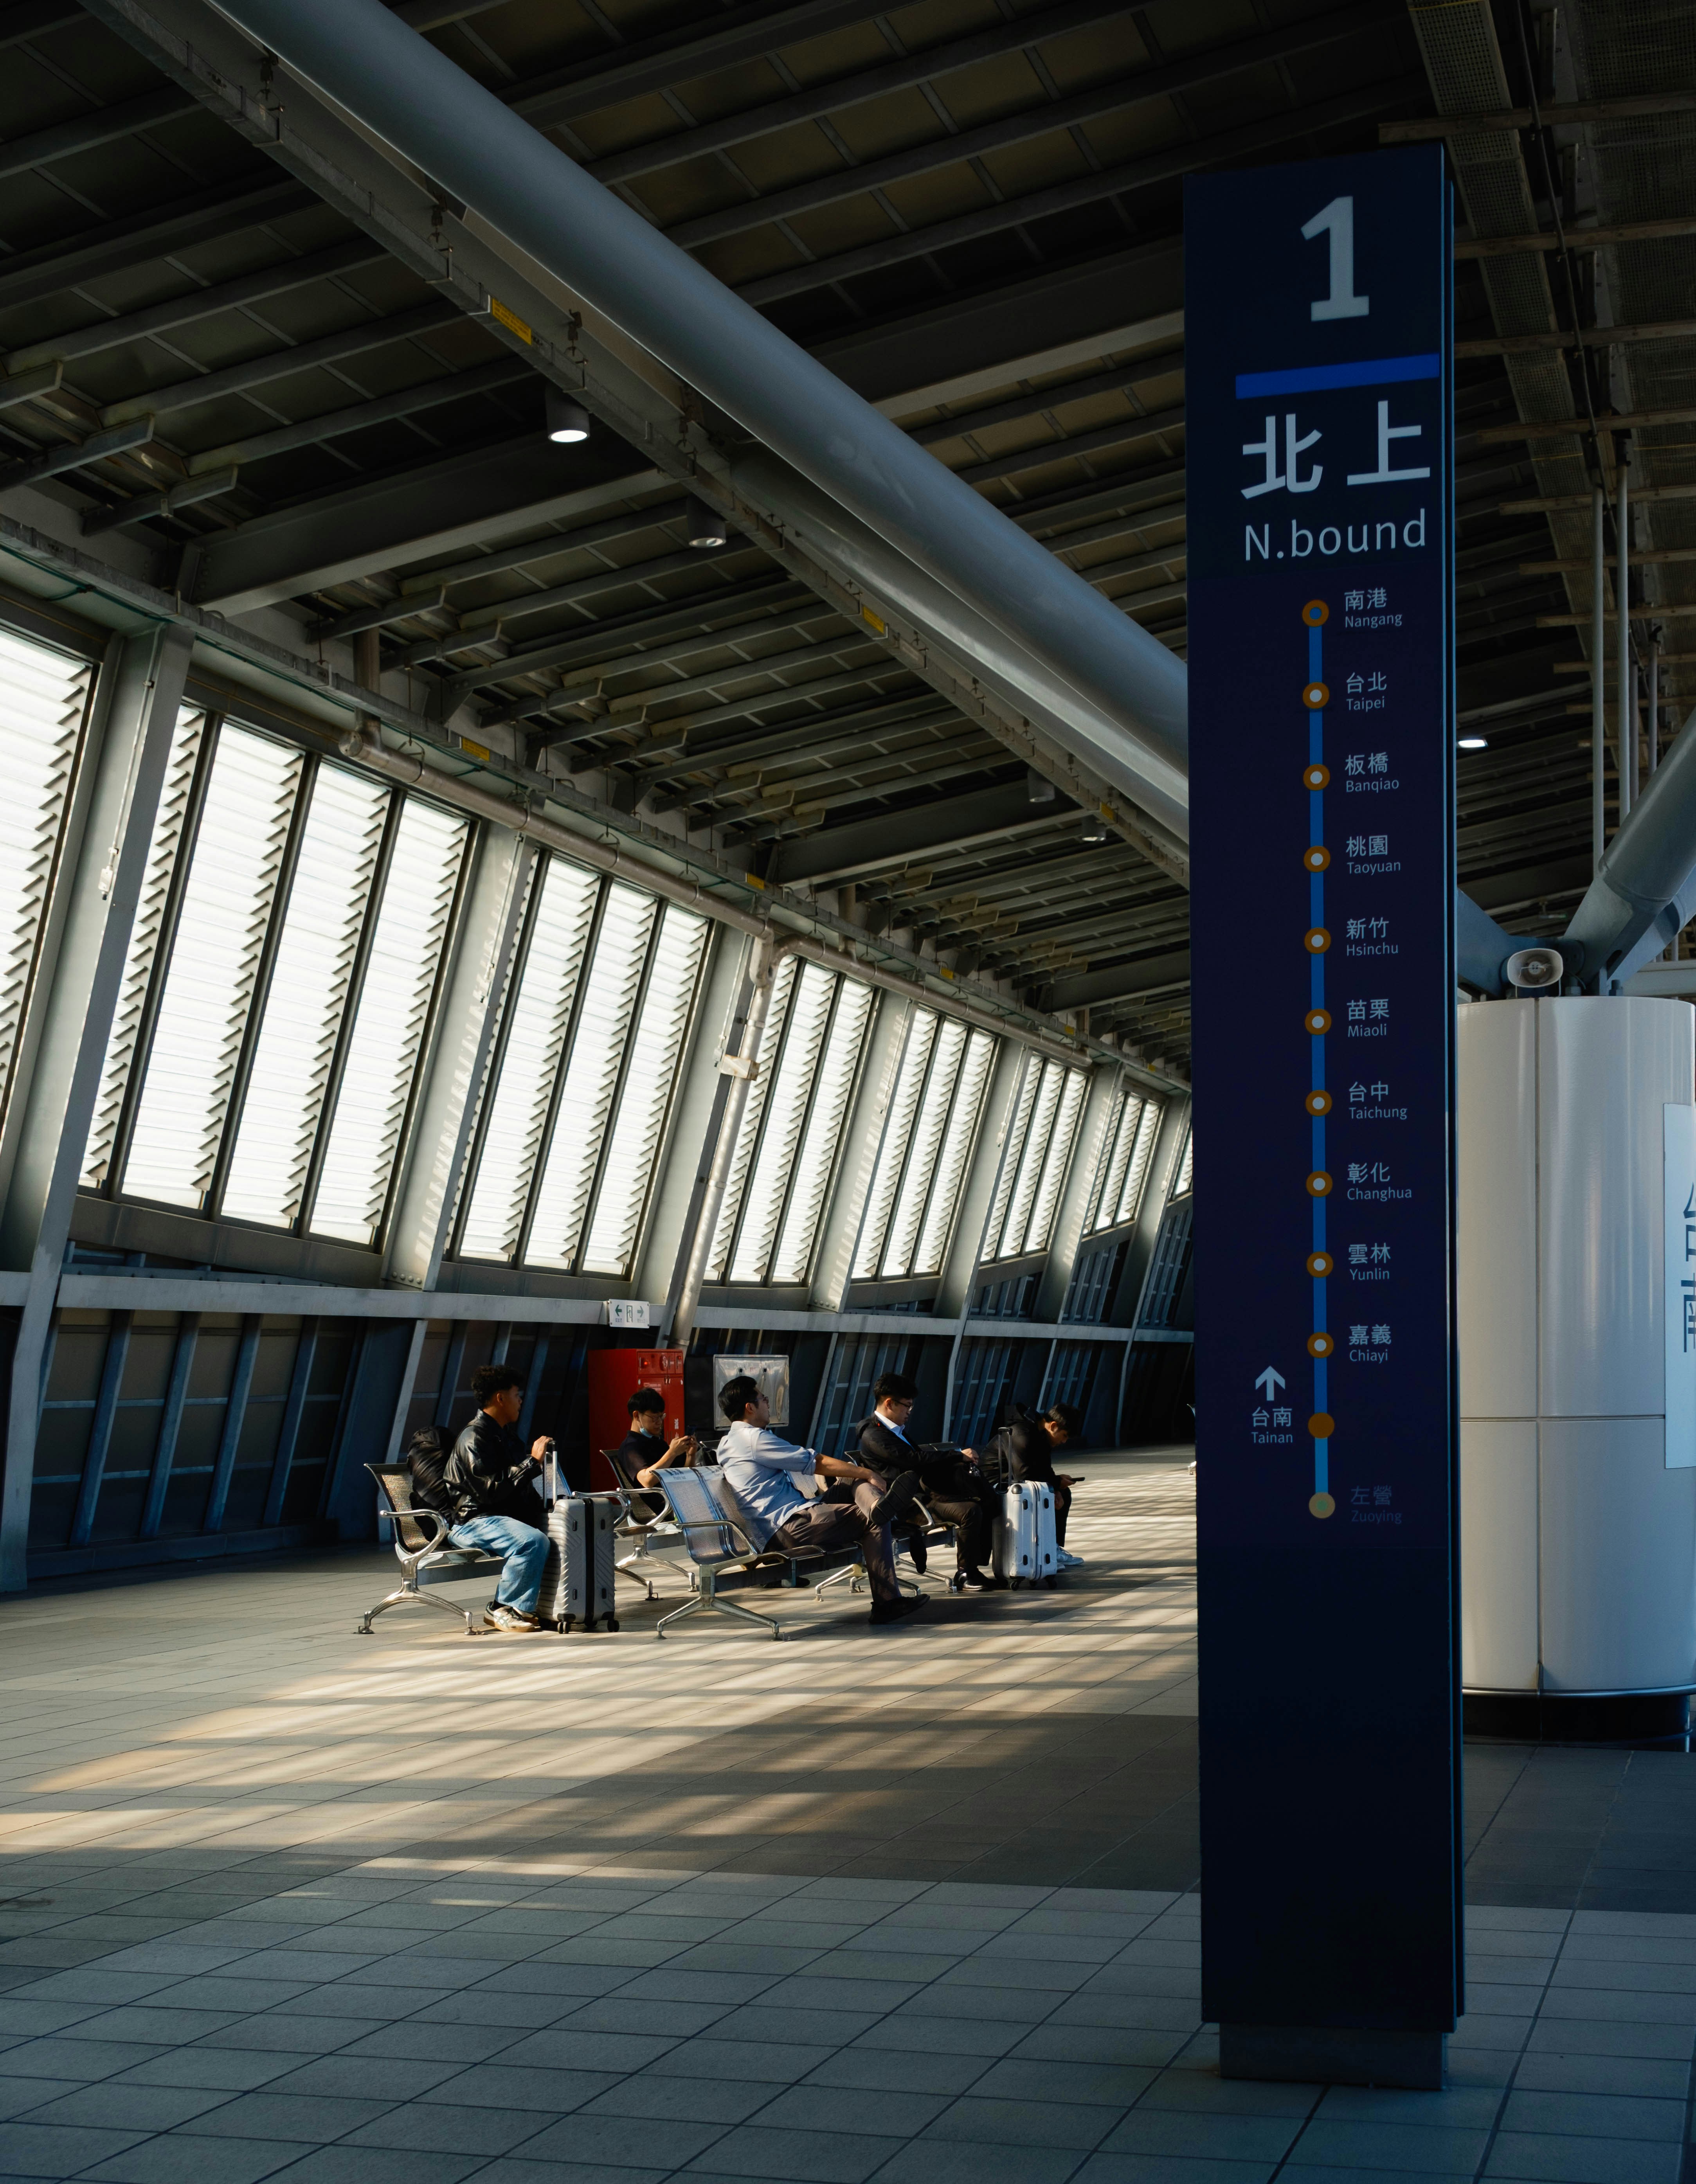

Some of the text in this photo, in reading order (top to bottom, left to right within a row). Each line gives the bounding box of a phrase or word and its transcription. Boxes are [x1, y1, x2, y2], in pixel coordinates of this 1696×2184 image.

[1301, 196, 1369, 321] 1
[1241, 400, 1430, 499] 北上
[1245, 508, 1425, 561] N.bound
[1344, 587, 1387, 612] 南港
[1345, 614, 1402, 628] Nangang
[1346, 671, 1387, 694] 台北
[1346, 696, 1385, 712] Taipei
[1345, 752, 1388, 776] 板橋
[1346, 778, 1399, 793] Banqiao
[1346, 835, 1388, 857] 桃園
[1347, 862, 1401, 875] Taoyuan
[1346, 917, 1389, 940] 新竹
[1347, 942, 1399, 956] Hsinchu
[1347, 998, 1390, 1021] 苗栗
[1348, 1023, 1387, 1037] Miaoli
[1349, 1081, 1388, 1103] 台中
[1349, 1106, 1407, 1120] Taichung
[1347, 1162, 1390, 1184] 彰化
[1347, 1186, 1412, 1202] Changhua
[1348, 1242, 1391, 1264] 雲林
[1349, 1268, 1390, 1281] Yunlin
[1349, 1324, 1392, 1345] 嘉義
[1349, 1349, 1388, 1364] Chiayi
[1252, 1407, 1292, 1427] 台南
[1251, 1431, 1293, 1444] Tainan
[1350, 1485, 1392, 1506] 左營
[1351, 1510, 1402, 1524] Zuoying
